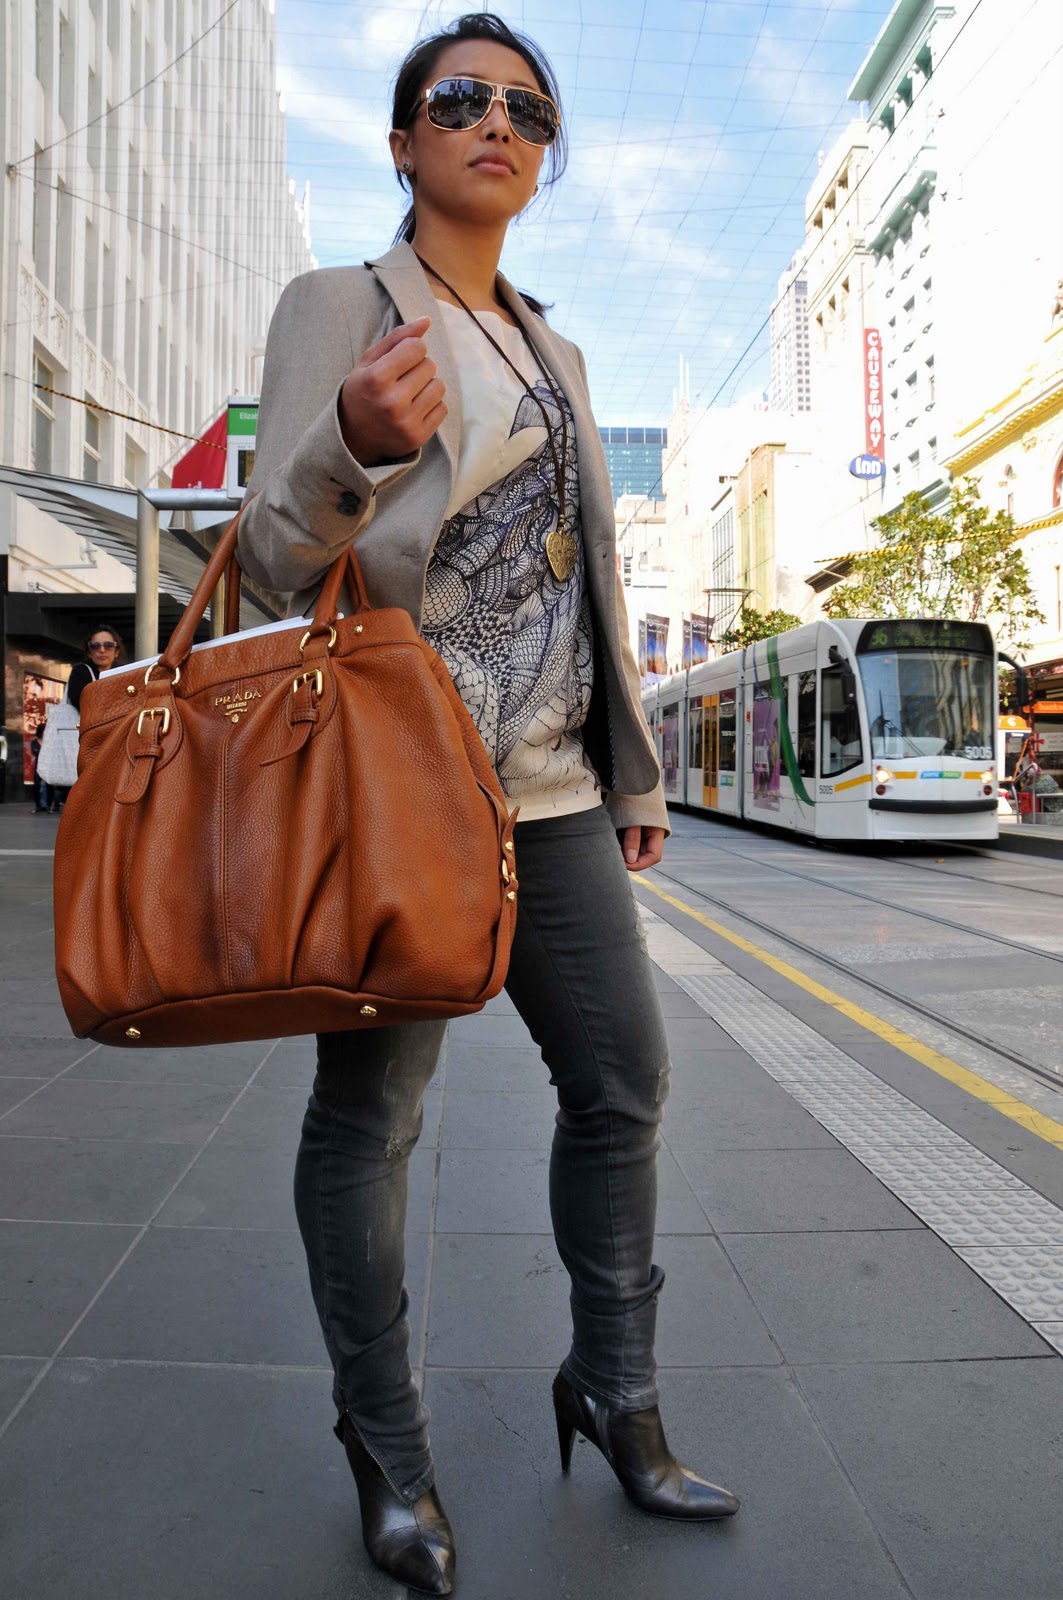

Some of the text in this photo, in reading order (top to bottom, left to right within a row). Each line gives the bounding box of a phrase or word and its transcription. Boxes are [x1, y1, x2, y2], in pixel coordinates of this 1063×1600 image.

[867, 332, 882, 447] CAUSEWAY
[855, 457, 881, 475] Inn
[215, 690, 262, 706] PRADA
[964, 745, 993, 760] 5005
[819, 785, 833, 794] 5005
